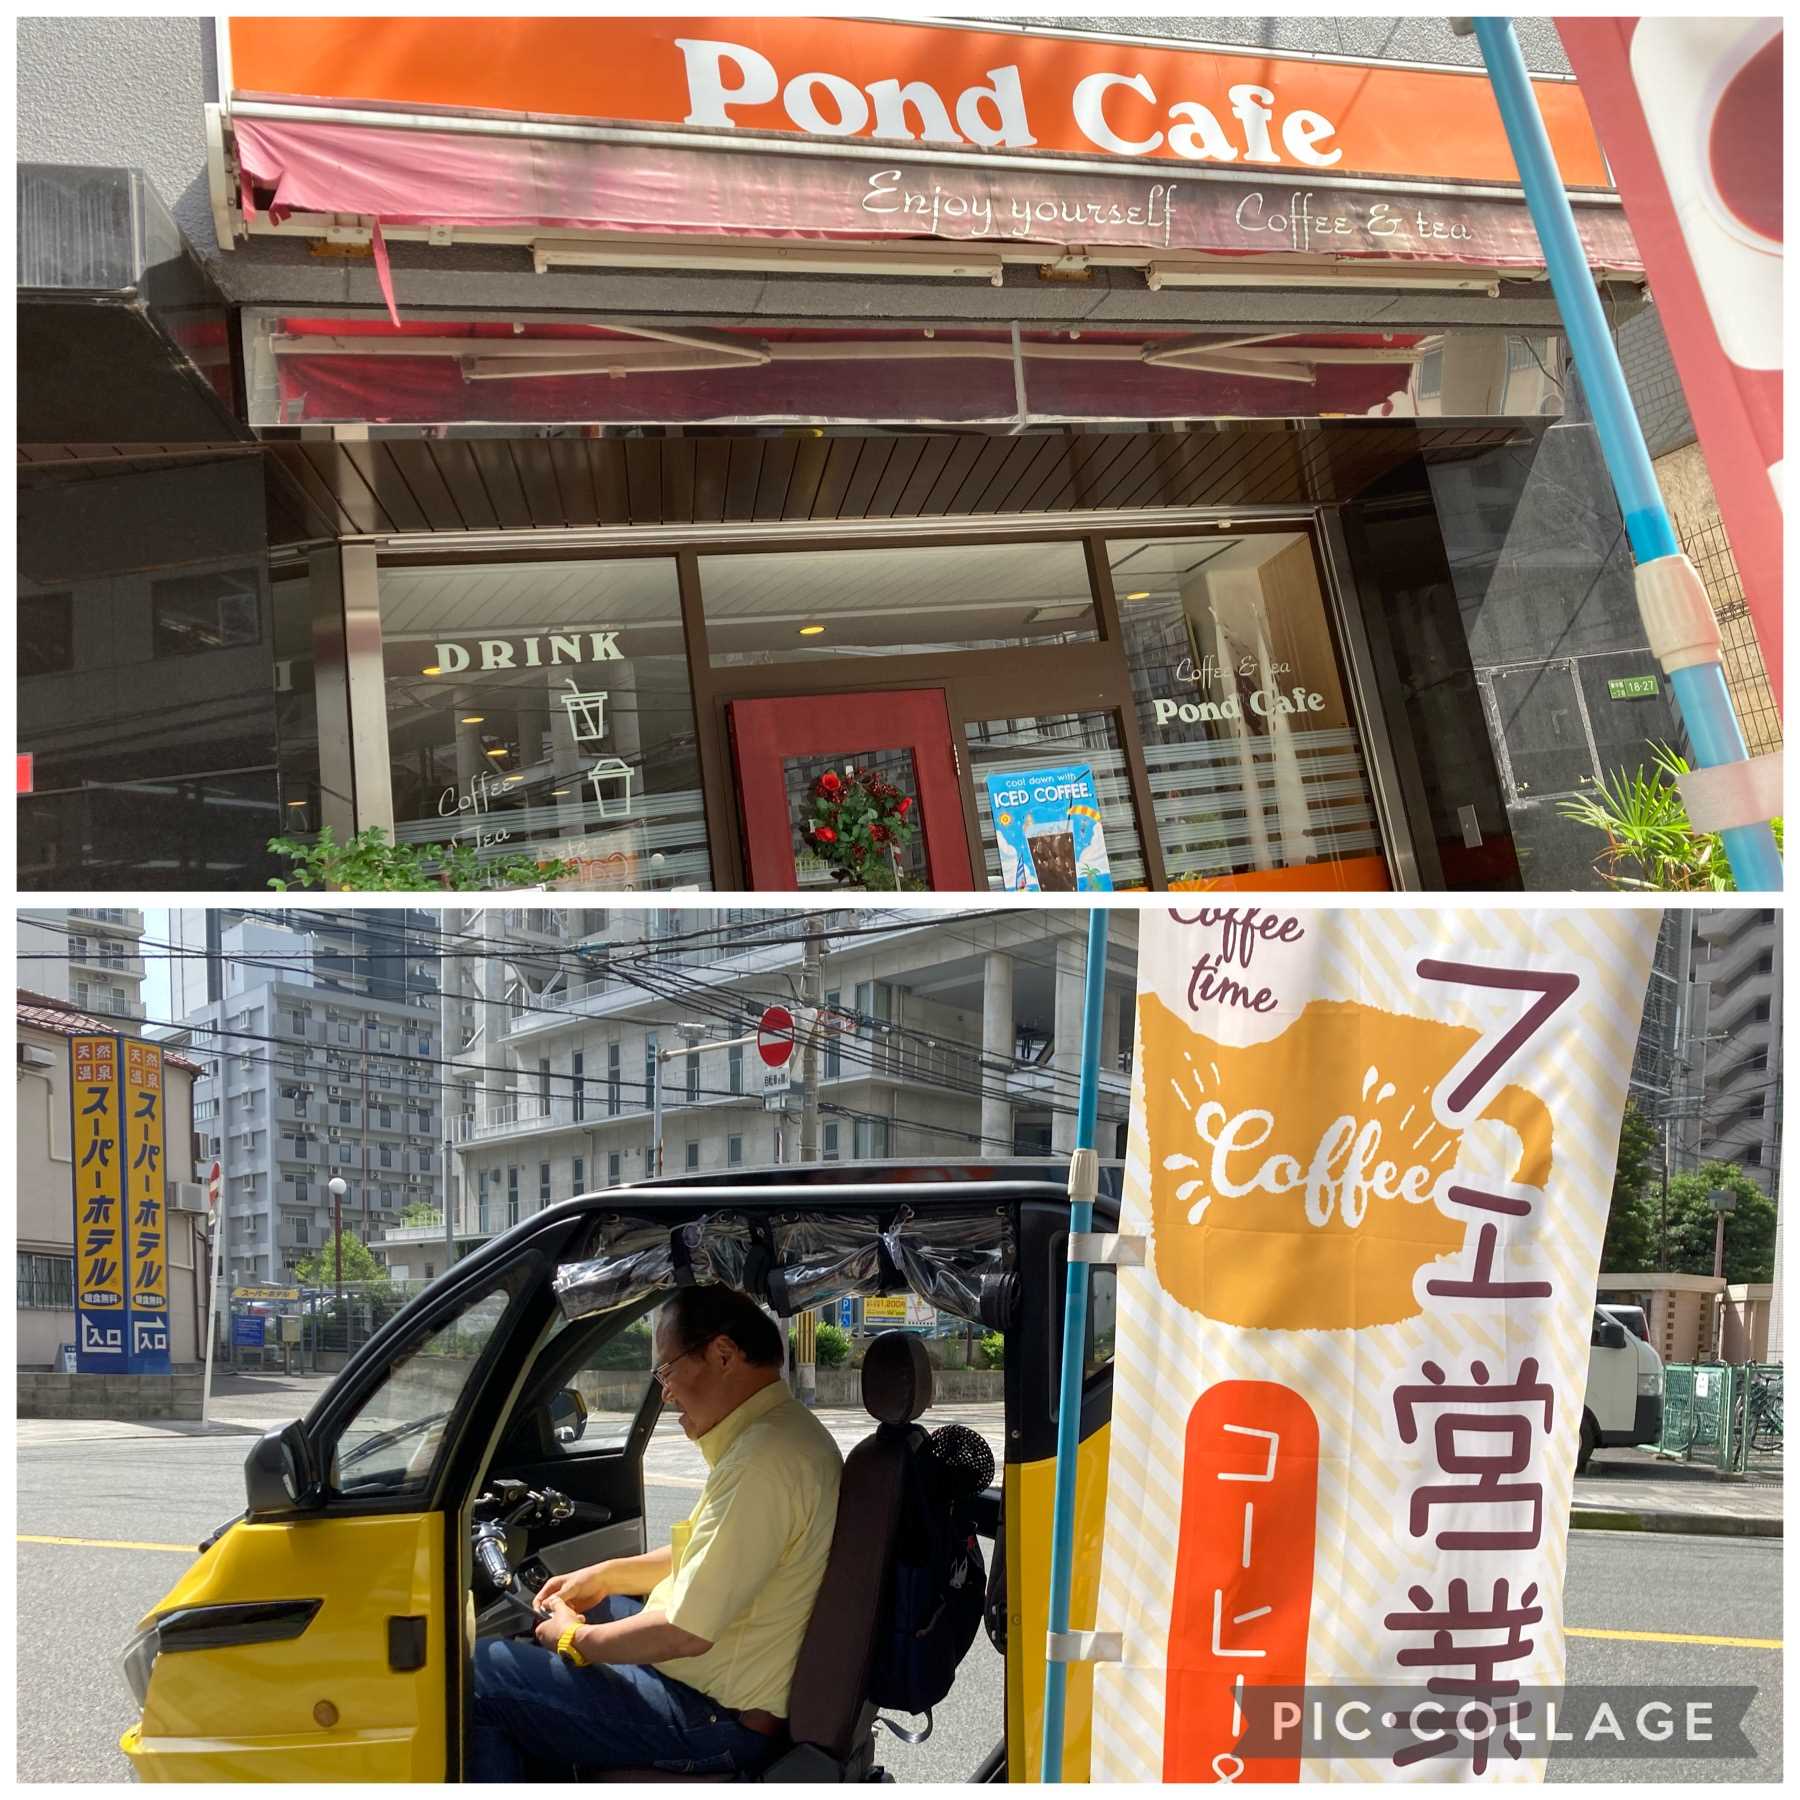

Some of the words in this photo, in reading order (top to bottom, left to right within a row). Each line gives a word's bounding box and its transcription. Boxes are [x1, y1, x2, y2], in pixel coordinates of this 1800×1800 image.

[674, 37, 1038, 149] Pond
[1072, 72, 1343, 167] Cafe
[860, 169, 999, 237] Enjoy
[1005, 184, 1177, 248] yourself
[1235, 191, 1353, 252] Coffee
[1367, 203, 1403, 236] &
[1416, 209, 1472, 241] tea
[433, 631, 625, 674] DRINK
[1152, 692, 1241, 726] Pond
[1249, 686, 1326, 717] Cafe
[438, 770, 515, 817] Coffee
[993, 789, 1030, 809] ICED
[1033, 782, 1093, 803] COFFEE.
[1005, 777, 1026, 788] cool
[1028, 776, 1055, 786] down
[1056, 772, 1078, 782] with
[450, 825, 512, 856] Tea
[1187, 952, 1279, 1013] time
[77, 1044, 112, 1060] 天然
[77, 1065, 113, 1081] 温泉
[1193, 1101, 1435, 1229] Coffee
[80, 1086, 117, 1288] スーパーホテル
[132, 1090, 162, 1290] スーパーホテル
[88, 1327, 122, 1346] 入口
[140, 1332, 167, 1351] 入口
